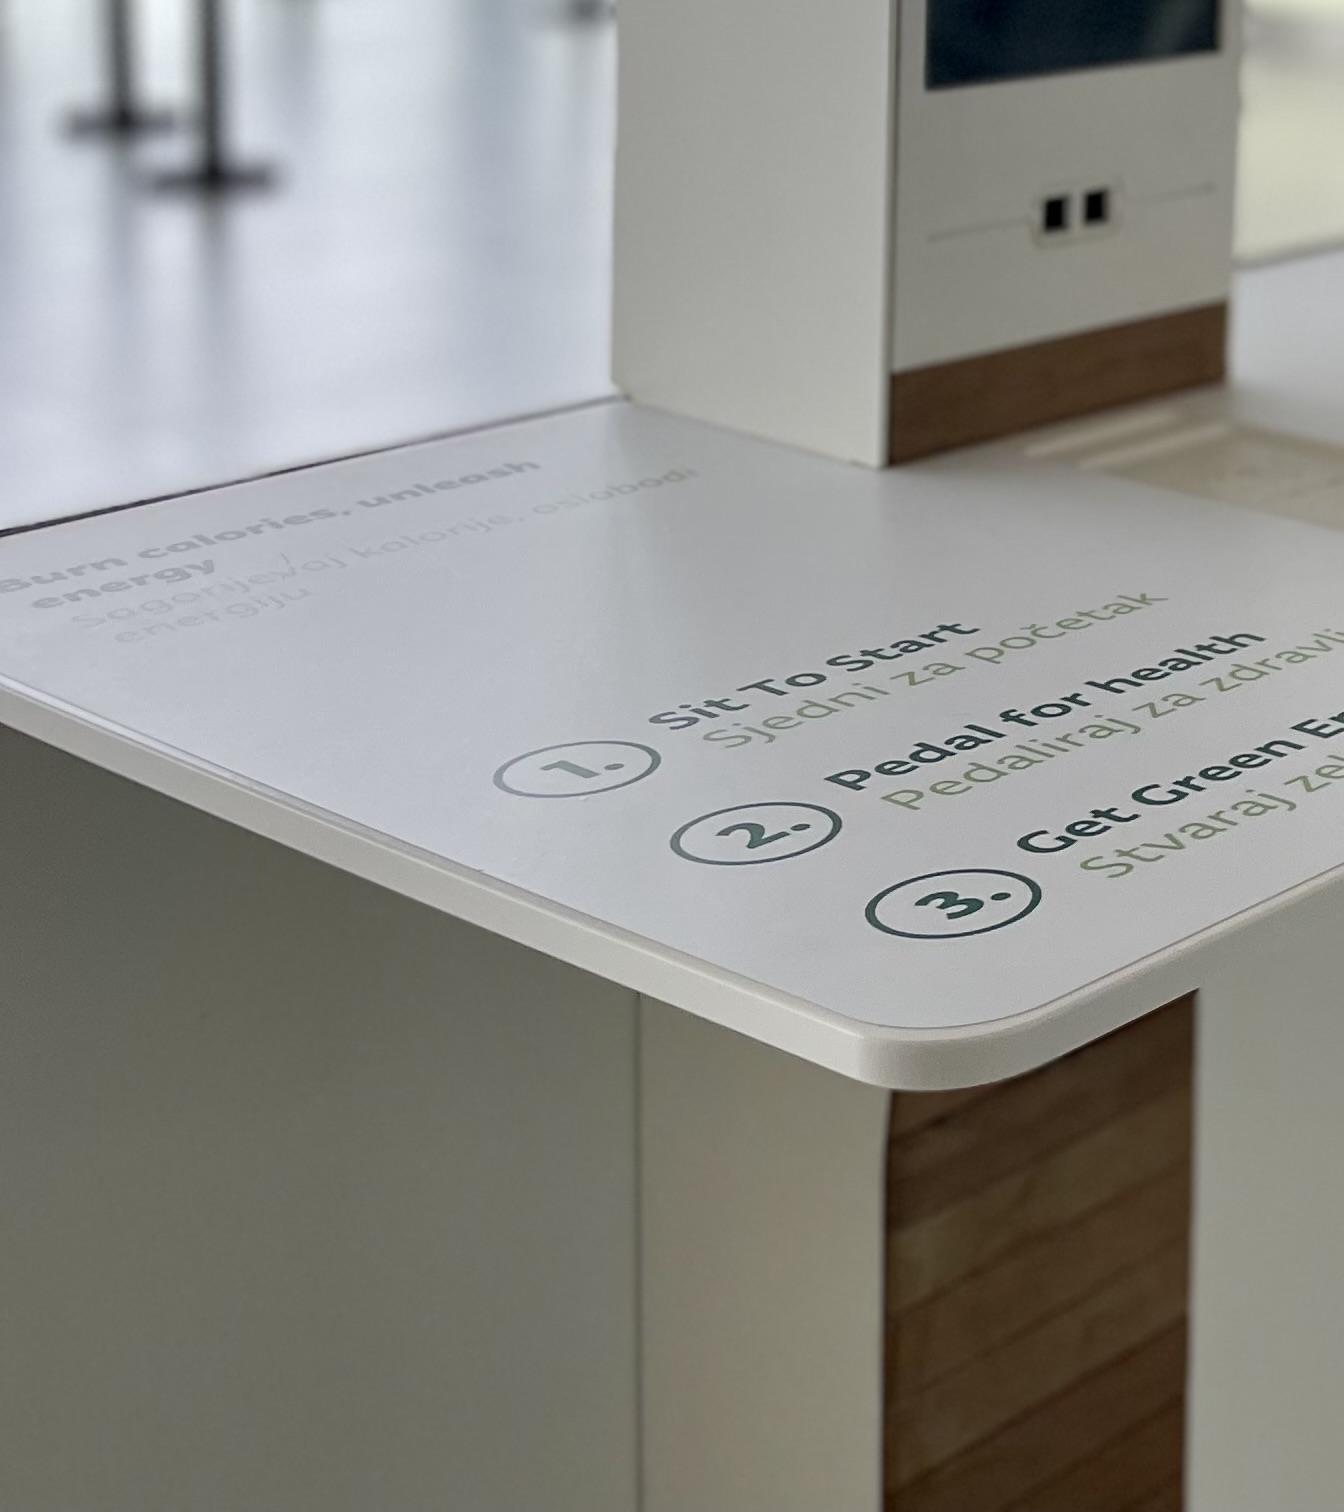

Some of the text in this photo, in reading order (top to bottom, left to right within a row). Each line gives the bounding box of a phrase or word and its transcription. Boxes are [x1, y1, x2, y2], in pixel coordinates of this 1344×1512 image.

[0, 460, 542, 594] Burn calories, unleash
[71, 468, 699, 628] Sagorijevaj kalorije, oslobodi
[31, 559, 216, 609] energy
[114, 588, 312, 643] energiju
[649, 622, 980, 730] Sit To Start
[703, 592, 1169, 749] Sjedni za početak
[824, 629, 1267, 791] Pedal for health
[540, 758, 625, 781] 1.
[881, 714, 1141, 811] Pedaliraj
[1132, 690, 1206, 719] za
[1016, 806, 1142, 855] Get
[1131, 737, 1308, 807] Green
[716, 821, 812, 850] 2.
[1080, 789, 1297, 879] Stvaraj
[914, 889, 1012, 921] 3.
